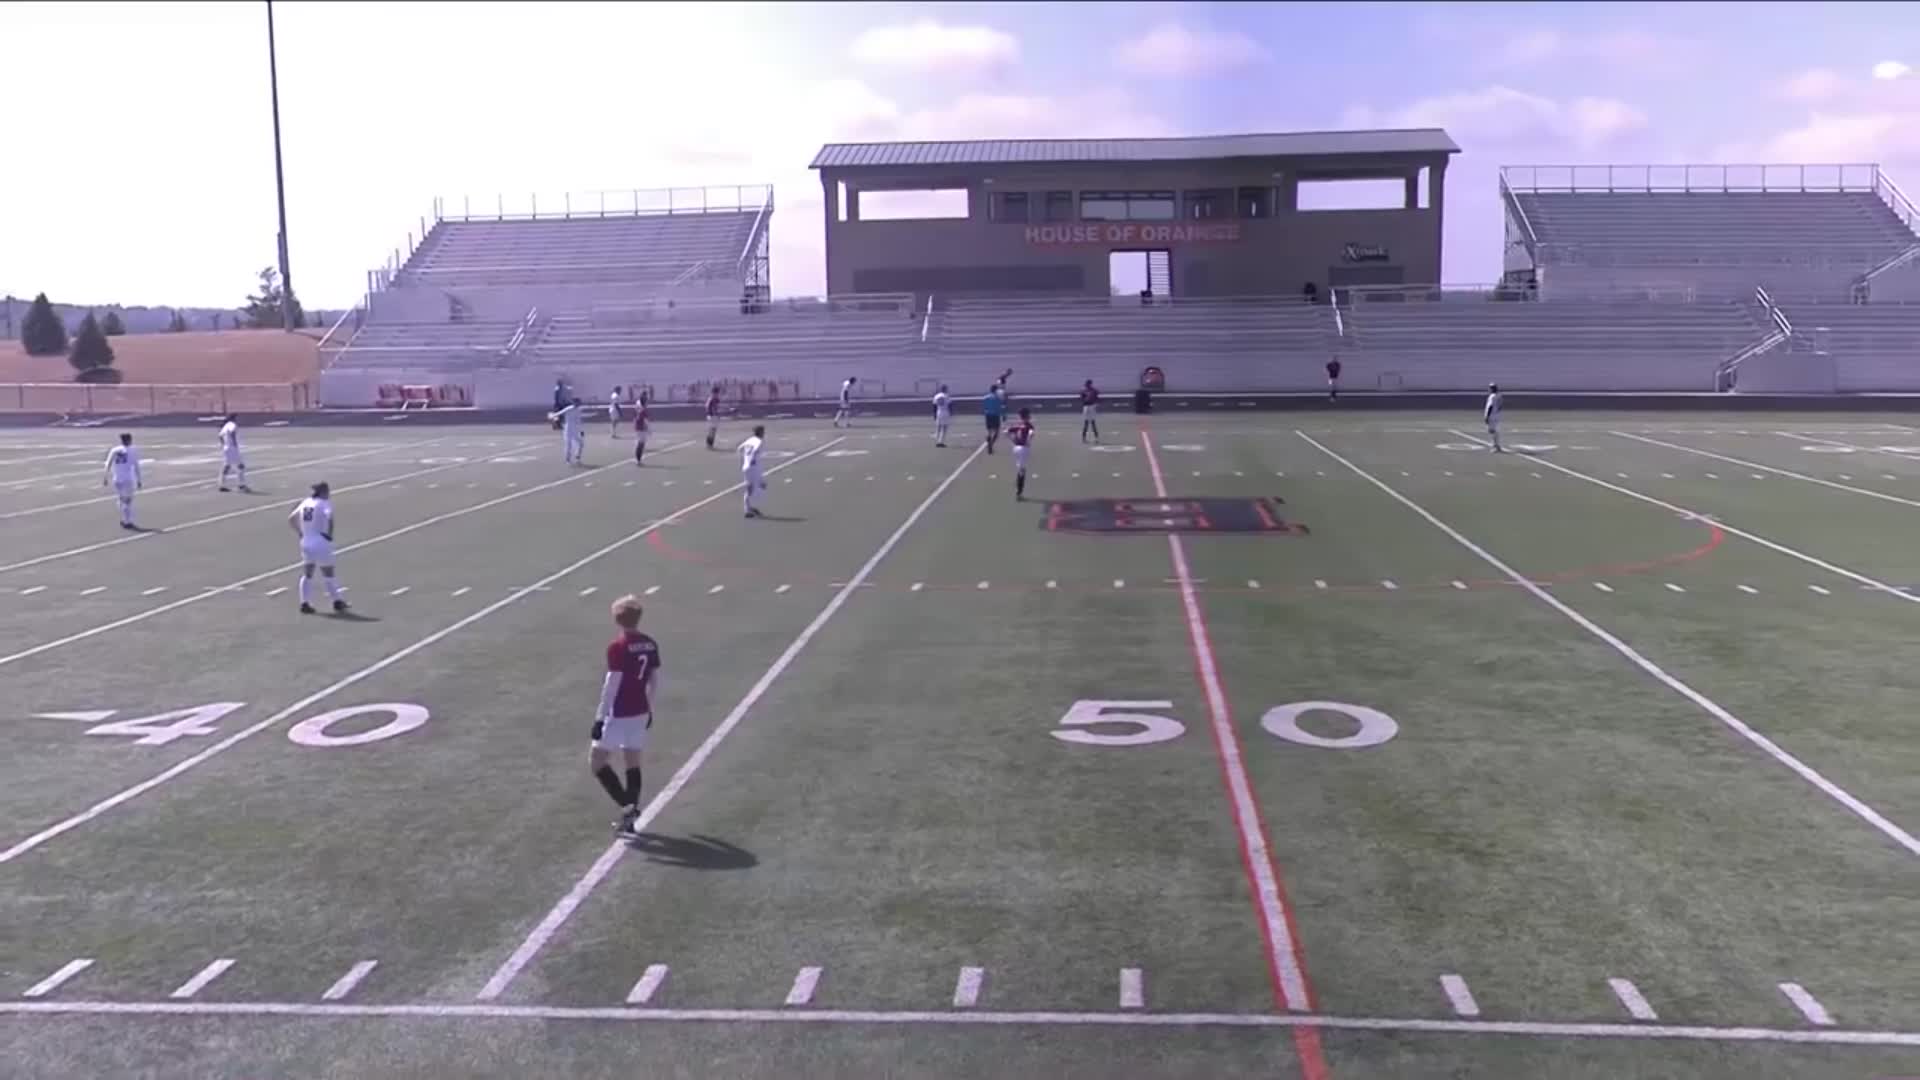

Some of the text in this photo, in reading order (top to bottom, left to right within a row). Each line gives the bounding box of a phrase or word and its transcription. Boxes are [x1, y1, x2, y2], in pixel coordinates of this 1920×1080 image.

[1024, 225, 1099, 243] HOUSE
[1106, 225, 1136, 242] OF
[637, 653, 649, 681] 7
